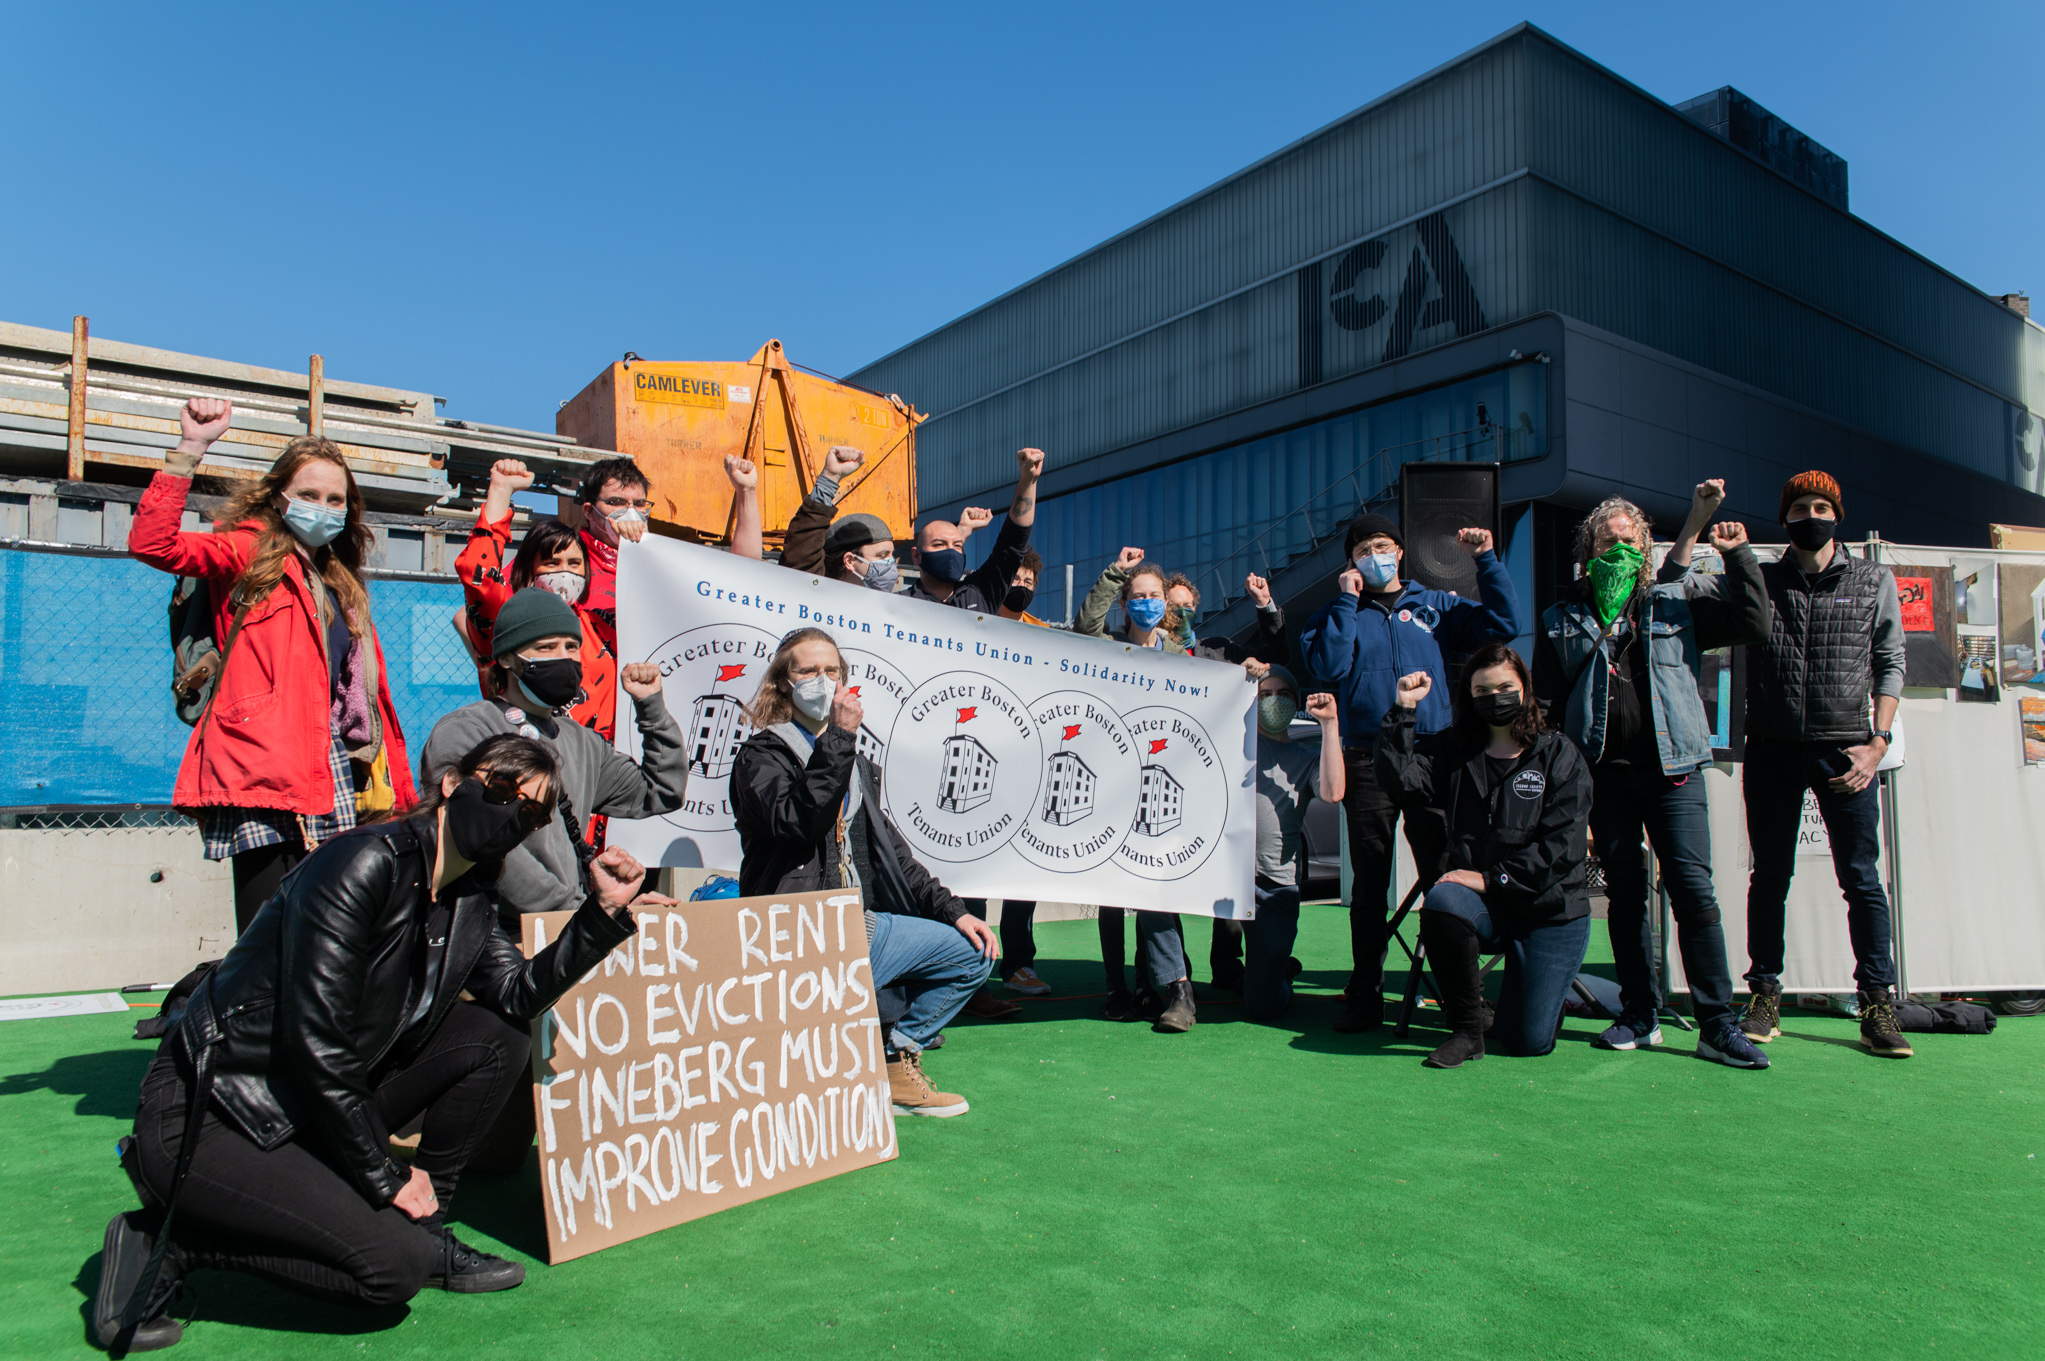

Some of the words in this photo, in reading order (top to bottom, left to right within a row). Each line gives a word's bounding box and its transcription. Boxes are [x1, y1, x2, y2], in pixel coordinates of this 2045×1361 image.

[1299, 211, 1490, 387] ICA
[635, 373, 721, 397] CAMLEVER
[864, 408, 870, 423] 2
[872, 409, 887, 427] TON
[658, 639, 747, 678] Greater
[697, 581, 785, 614] Greater
[799, 604, 871, 633] Boston
[884, 623, 963, 652] Tenants
[976, 642, 1033, 665] Union
[1060, 659, 1155, 691] Solidarity
[1165, 679, 1209, 698] Now!
[911, 685, 975, 722] Greater
[981, 685, 1032, 740] Boston
[1085, 704, 1129, 755] Boston
[1172, 719, 1213, 768] Boston
[907, 802, 962, 848] Tenants
[966, 813, 1013, 847] Union
[1021, 820, 1070, 859] enants
[1073, 825, 1116, 858] Union
[1120, 844, 1164, 868] nants
[1166, 835, 1205, 867] Union
[738, 894, 860, 969] RENT
[541, 992, 630, 1060] NO
[646, 957, 870, 1046] EVICTIONS
[540, 1036, 766, 1153] FINEBERG
[779, 1017, 881, 1088] MUST
[548, 1121, 724, 1242] IMPROVE
